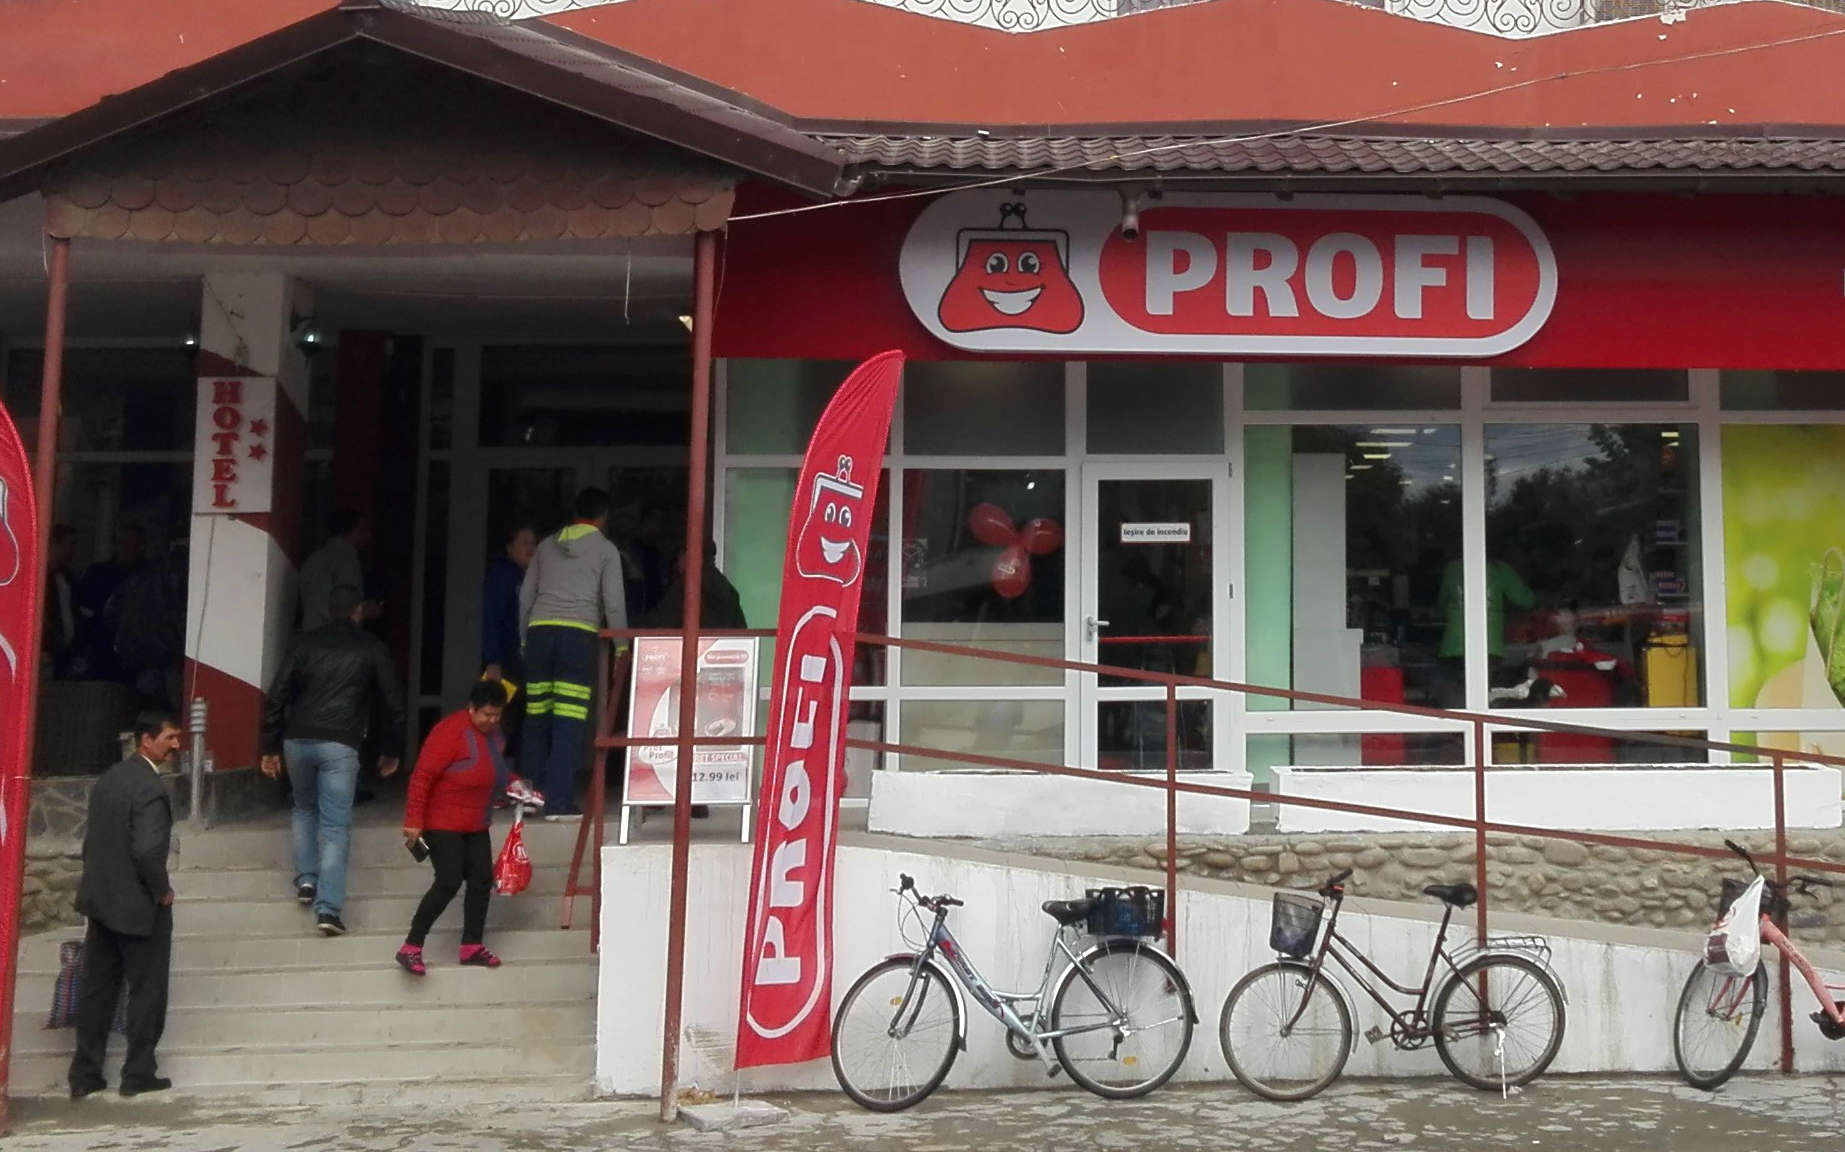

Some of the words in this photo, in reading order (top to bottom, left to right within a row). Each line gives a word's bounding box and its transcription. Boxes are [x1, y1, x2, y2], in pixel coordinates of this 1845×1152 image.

[1145, 230, 1494, 320] PROFI
[210, 380, 243, 508] HOTEL
[1146, 527, 1156, 536] de
[693, 771, 723, 782] 12.99
[725, 771, 740, 782] lei
